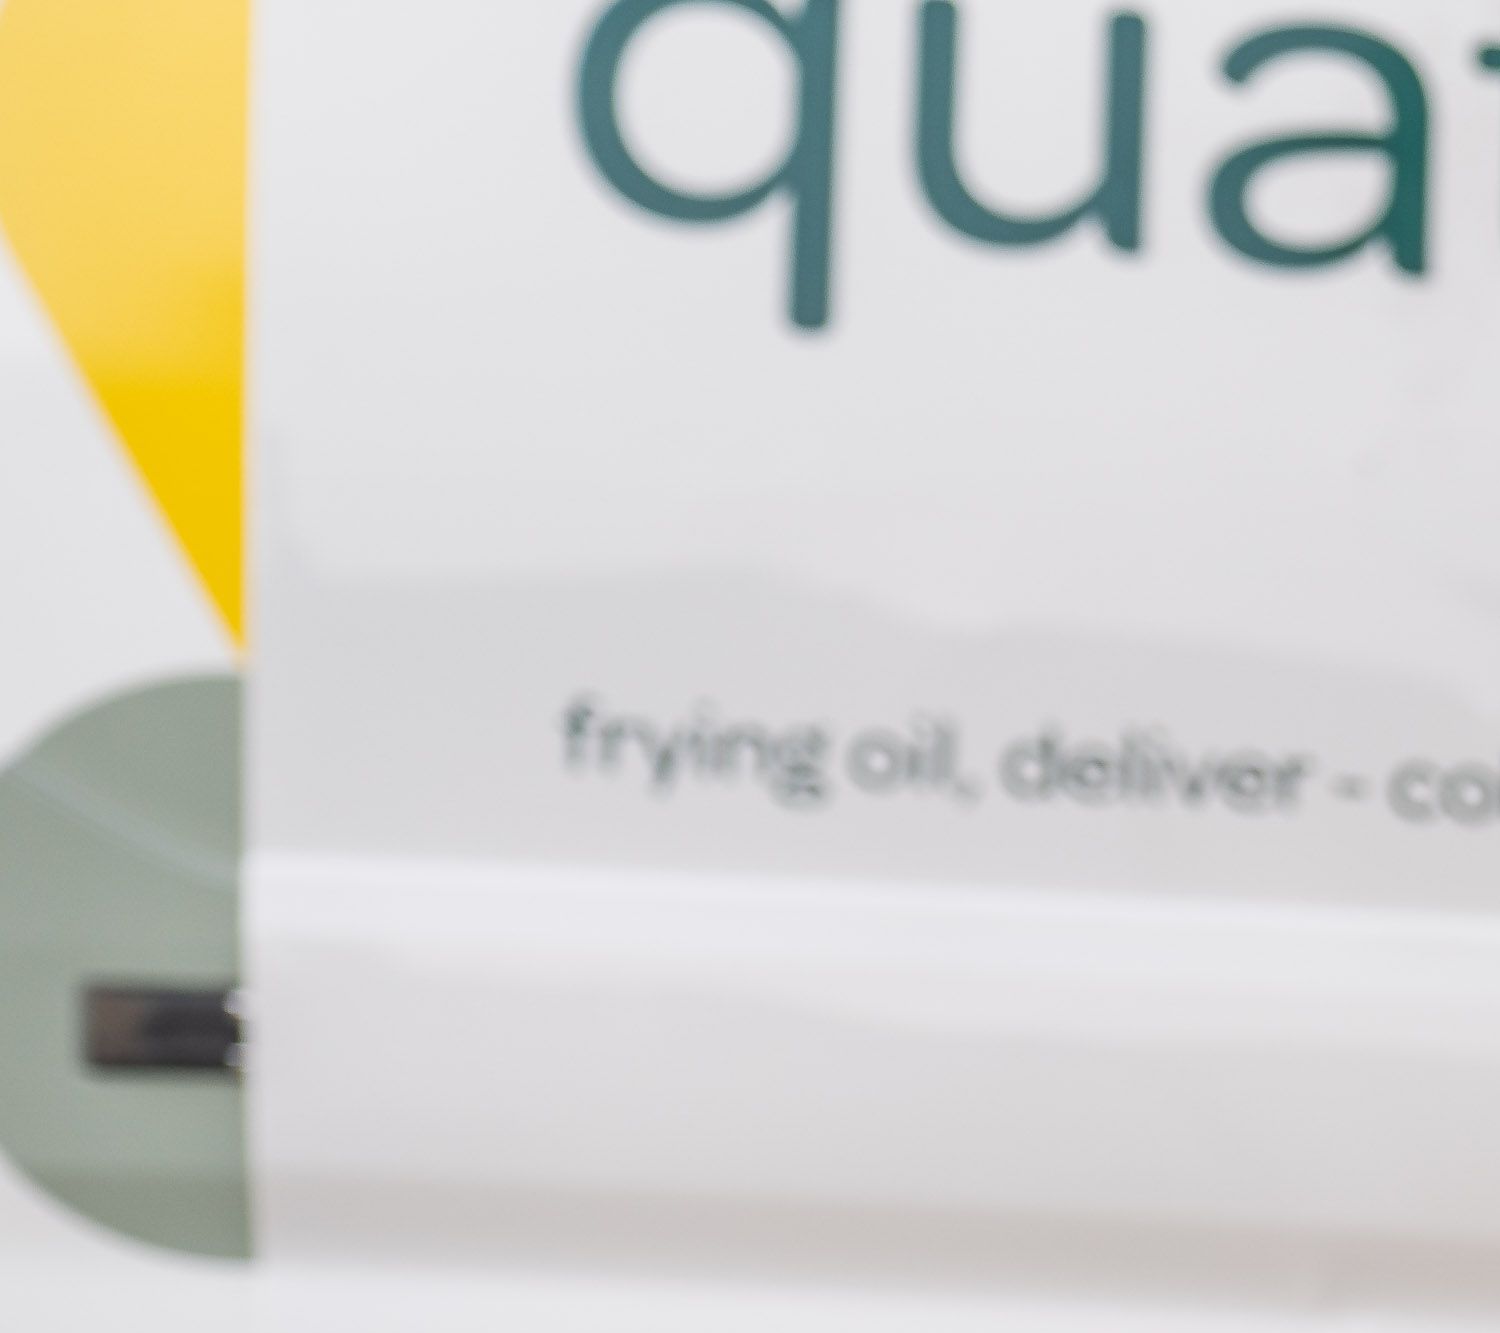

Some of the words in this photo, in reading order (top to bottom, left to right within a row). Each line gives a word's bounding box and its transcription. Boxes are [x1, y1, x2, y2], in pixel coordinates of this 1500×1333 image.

[561, 696, 834, 809] frying
[845, 716, 981, 807] oil,
[1000, 730, 1314, 812] deliver
